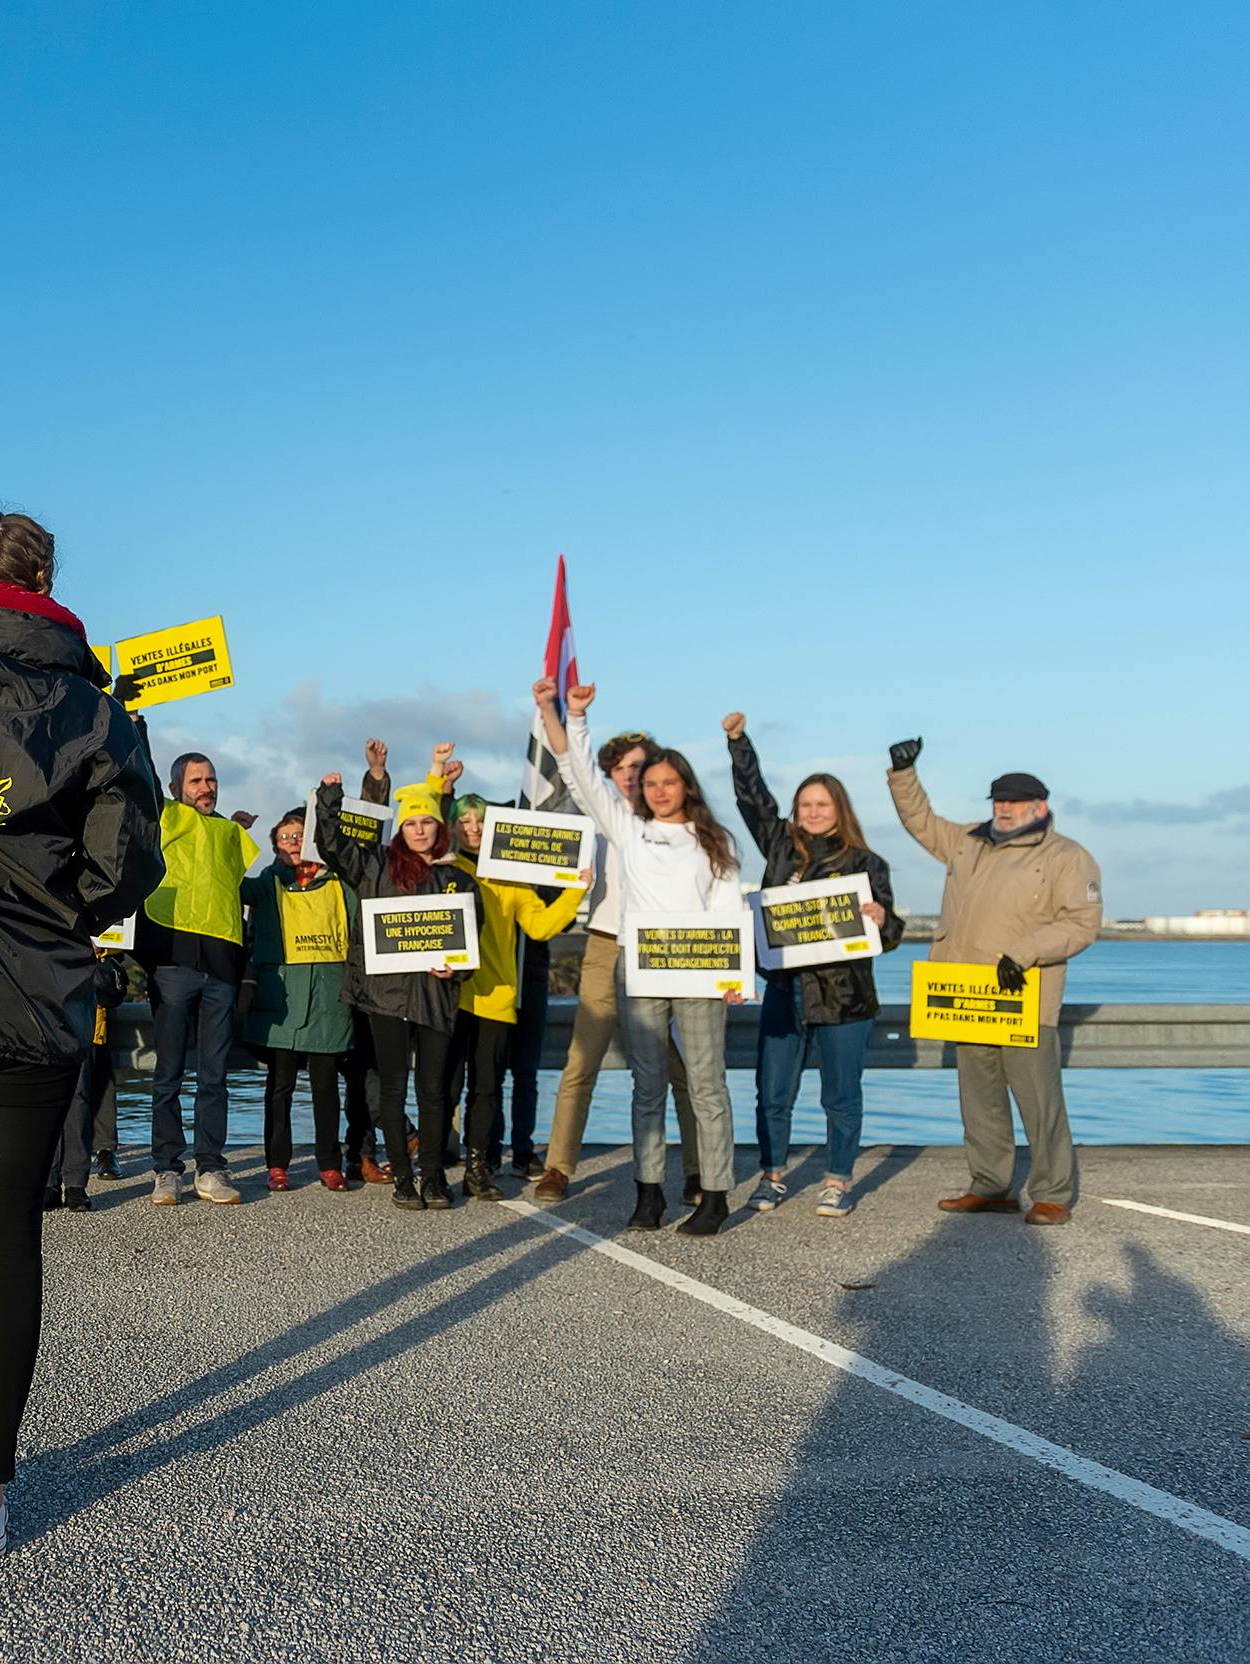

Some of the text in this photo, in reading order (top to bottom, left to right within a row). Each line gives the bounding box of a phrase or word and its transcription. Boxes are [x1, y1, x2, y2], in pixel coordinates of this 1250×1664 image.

[131, 637, 212, 666] VENTES ILLÉGALES
[141, 663, 218, 691] PAS DANS MON PORT
[496, 823, 512, 834] LES
[381, 912, 413, 925] VENTES
[413, 910, 451, 922] D'ARMES
[841, 909, 854, 921] LA
[386, 924, 454, 938] UNE HYPOCRISIE
[721, 929, 733, 941] LA
[295, 934, 332, 945] AMNESTY
[397, 938, 444, 952] FRANÇAISE
[927, 982, 1023, 997] VENTES ILLÉG
